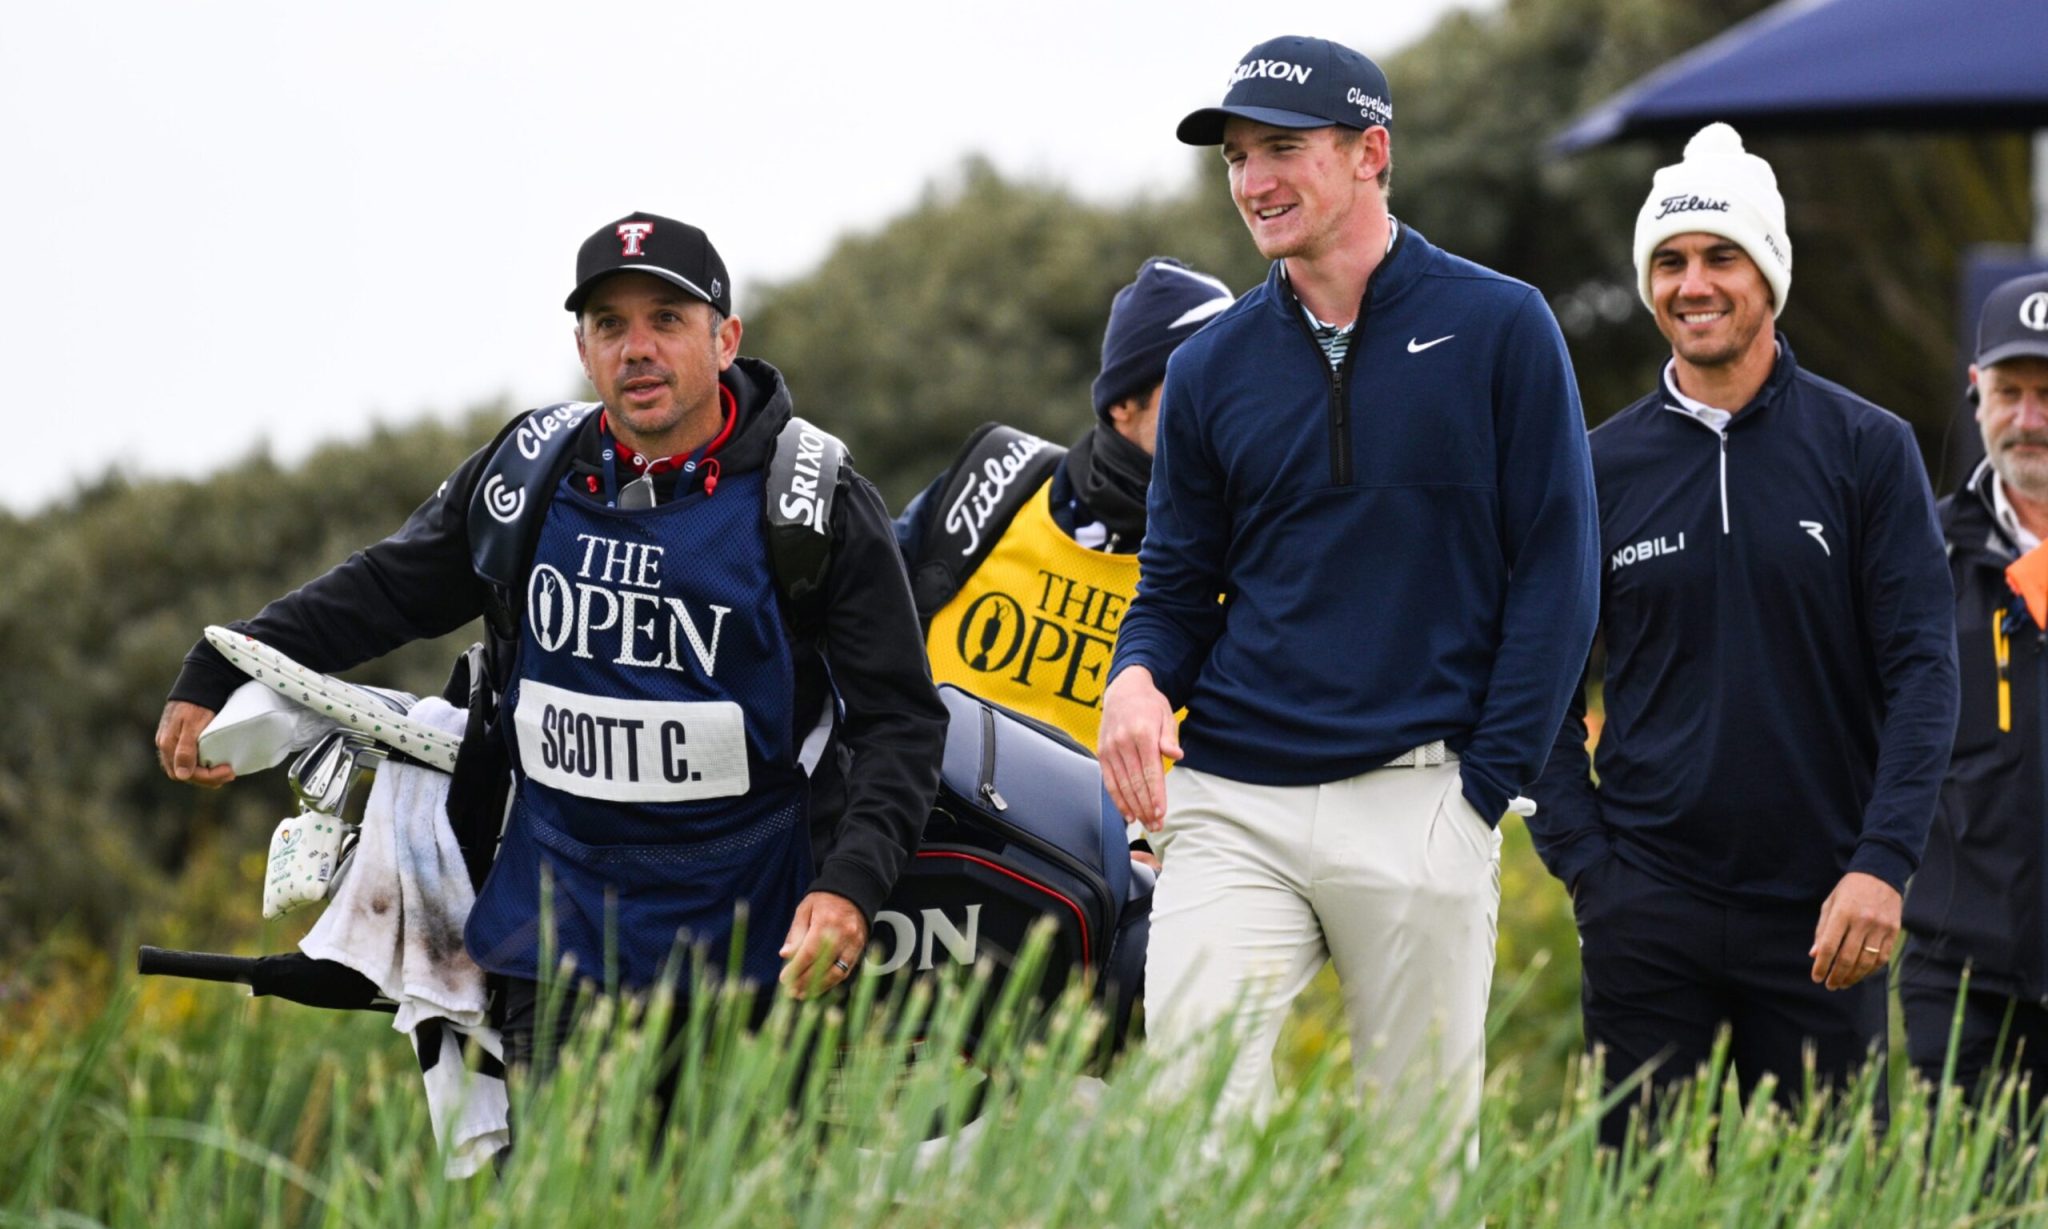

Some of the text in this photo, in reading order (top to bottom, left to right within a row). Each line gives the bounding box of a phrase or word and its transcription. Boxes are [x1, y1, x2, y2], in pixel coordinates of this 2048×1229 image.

[1655, 194, 1731, 220] Titleist
[577, 533, 664, 588] THE
[1612, 531, 1685, 571] NOBILI
[527, 563, 732, 677] OPEN
[1037, 569, 1127, 635] THE
[956, 591, 1113, 712] OPE
[541, 703, 702, 784] SCOTT C.
